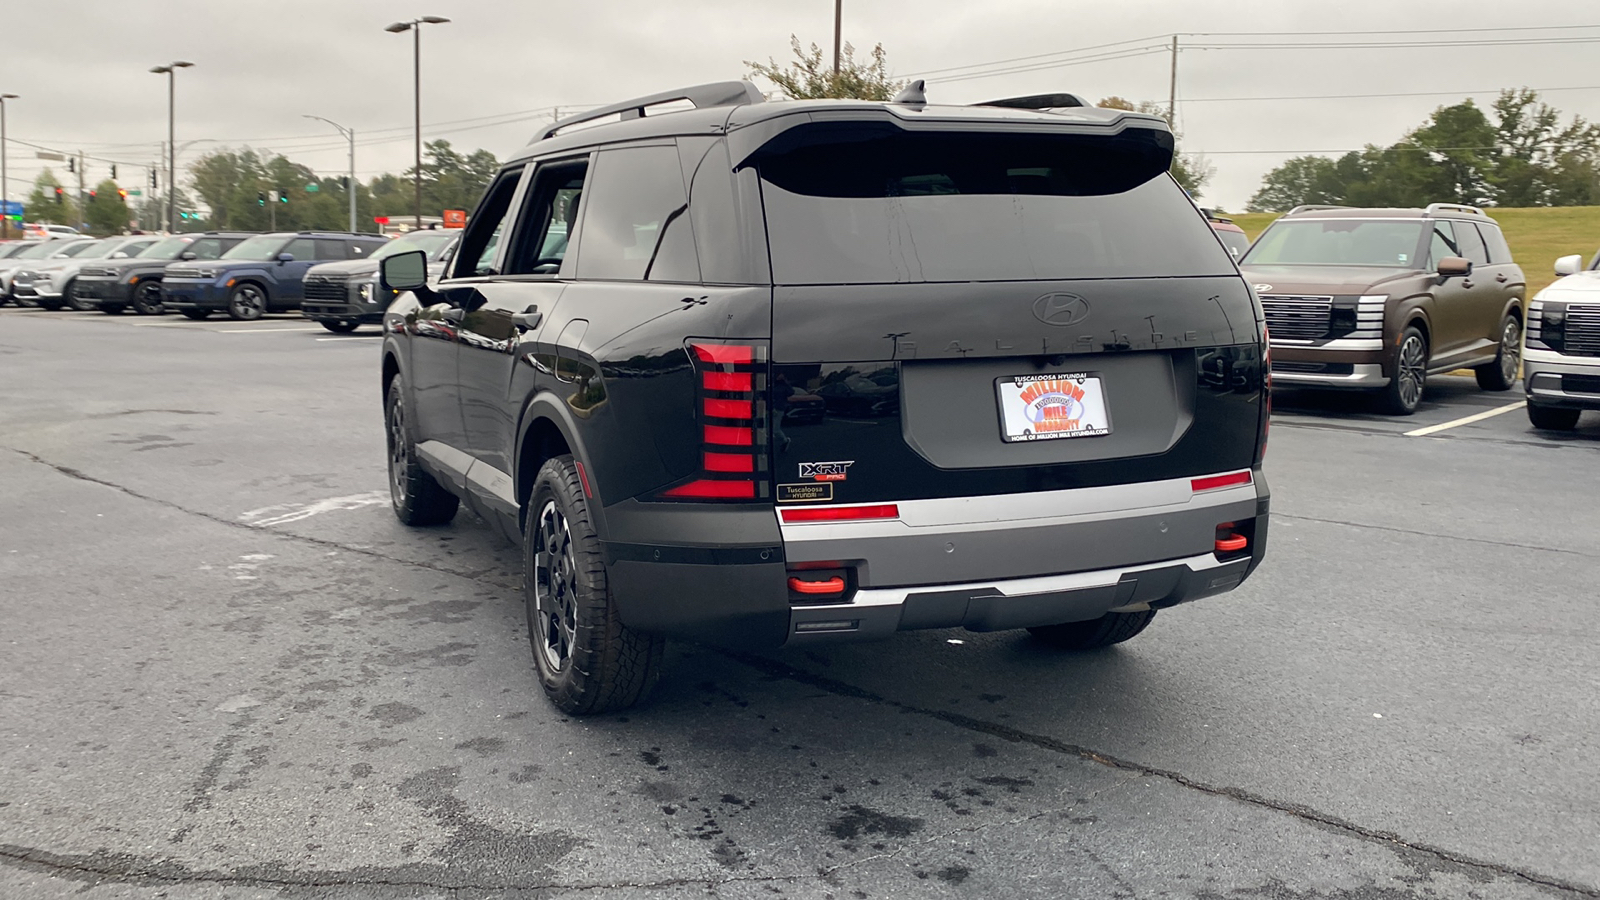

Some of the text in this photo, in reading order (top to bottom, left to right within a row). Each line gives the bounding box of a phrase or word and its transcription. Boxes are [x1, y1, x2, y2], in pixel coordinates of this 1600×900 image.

[1020, 380, 1085, 405] MILLION
[1043, 406, 1068, 420] MILE
[1033, 419, 1080, 433] WARRANTY
[798, 461, 855, 478] XRT
